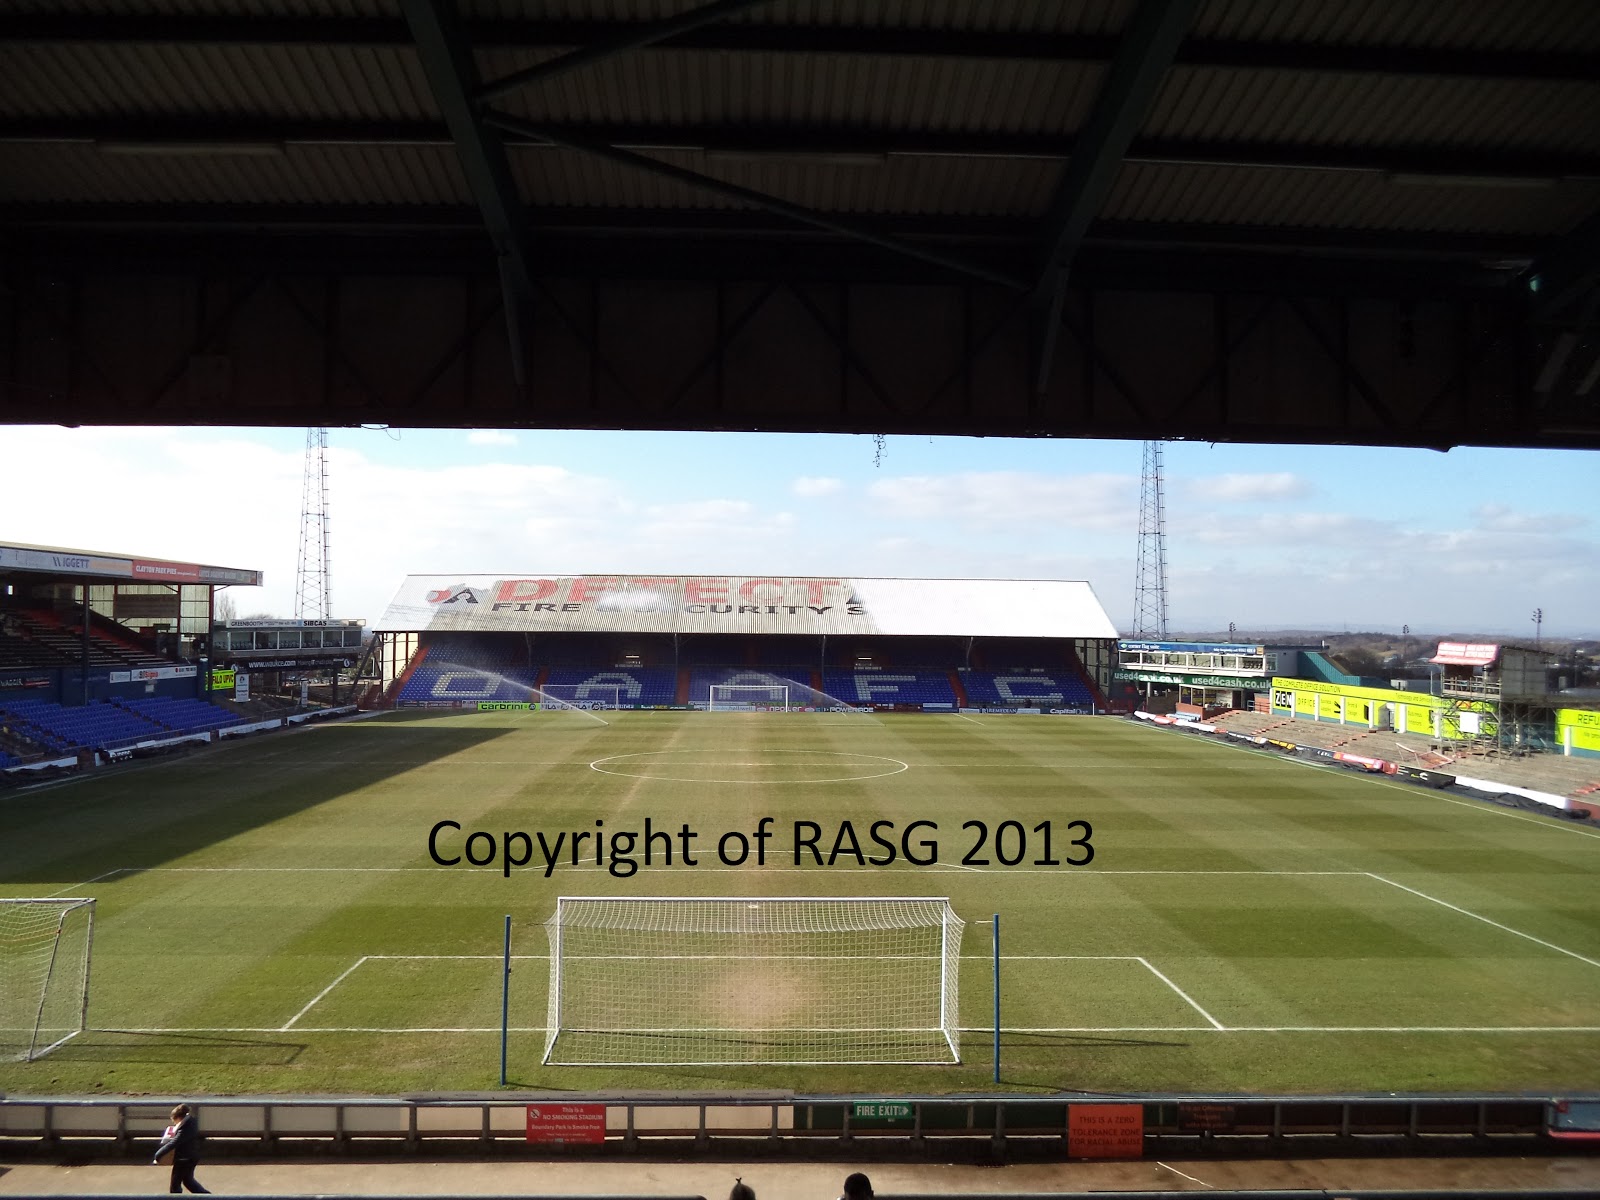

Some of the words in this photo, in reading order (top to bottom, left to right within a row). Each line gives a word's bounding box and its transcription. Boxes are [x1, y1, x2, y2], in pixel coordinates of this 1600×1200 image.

[136, 565, 155, 573] CLAYTON
[155, 566, 167, 574] PARK
[491, 602, 582, 612] FIRE
[1192, 676, 1272, 689] used4cash.co.uk
[1275, 691, 1292, 707] ZEN
[481, 702, 523, 710] carbrini
[856, 1105, 875, 1116] FIRE
[878, 1105, 899, 1116] EXIT
[1079, 1116, 1096, 1124] THIS
[1098, 1116, 1105, 1124] IS
[1107, 1116, 1113, 1124] A
[1115, 1116, 1135, 1124] ZERO
[1072, 1128, 1117, 1136] TOLERANCE
[1120, 1128, 1140, 1136] ZONE
[1069, 1137, 1085, 1145] FOR
[1087, 1137, 1113, 1145] RACIAL
[1118, 1137, 1141, 1145] ABUSE
